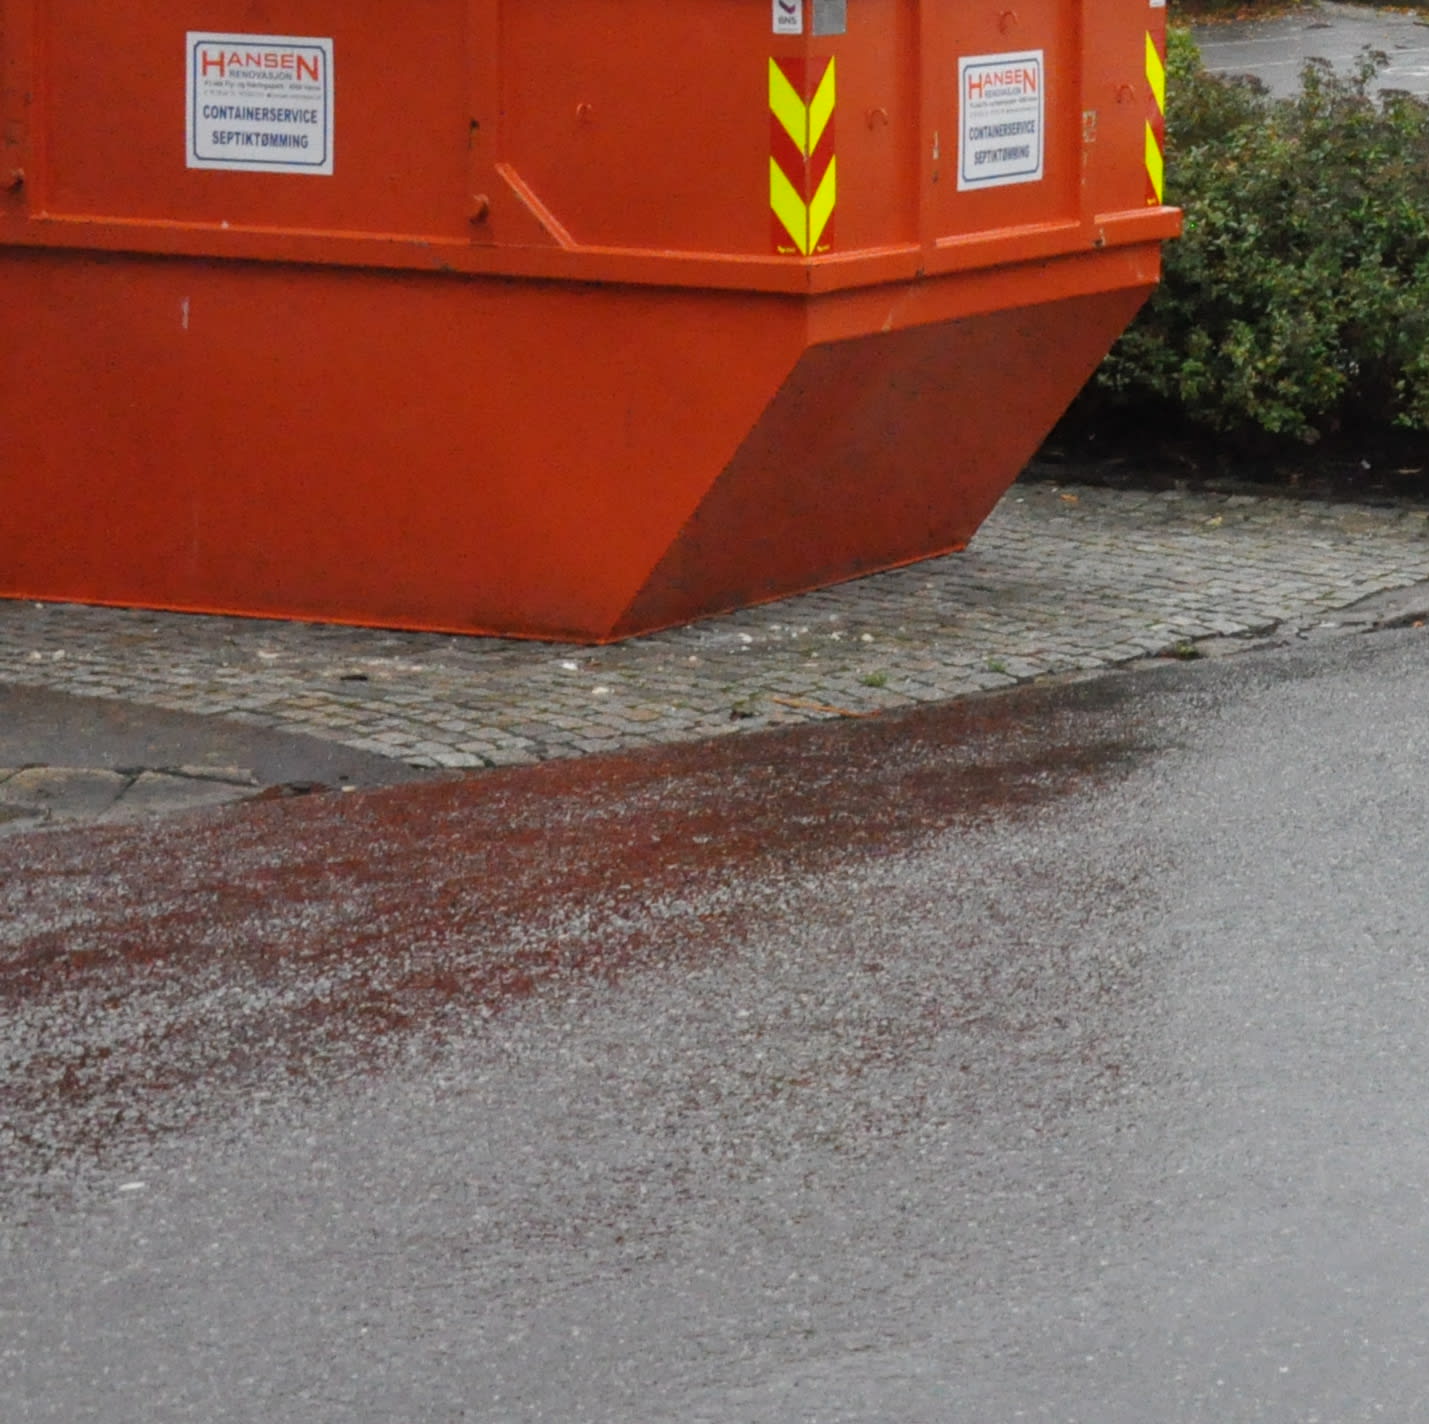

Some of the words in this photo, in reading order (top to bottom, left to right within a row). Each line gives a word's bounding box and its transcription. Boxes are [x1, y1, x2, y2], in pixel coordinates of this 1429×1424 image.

[202, 50, 319, 81] HANSEN
[229, 69, 292, 80] RENOVASJON
[968, 67, 1036, 100] HANSEN
[203, 105, 318, 124] CONTAINERSERVICE
[212, 130, 309, 149] SEPTIKTØMMING
[969, 120, 1036, 141] CONTAINERSERVICE
